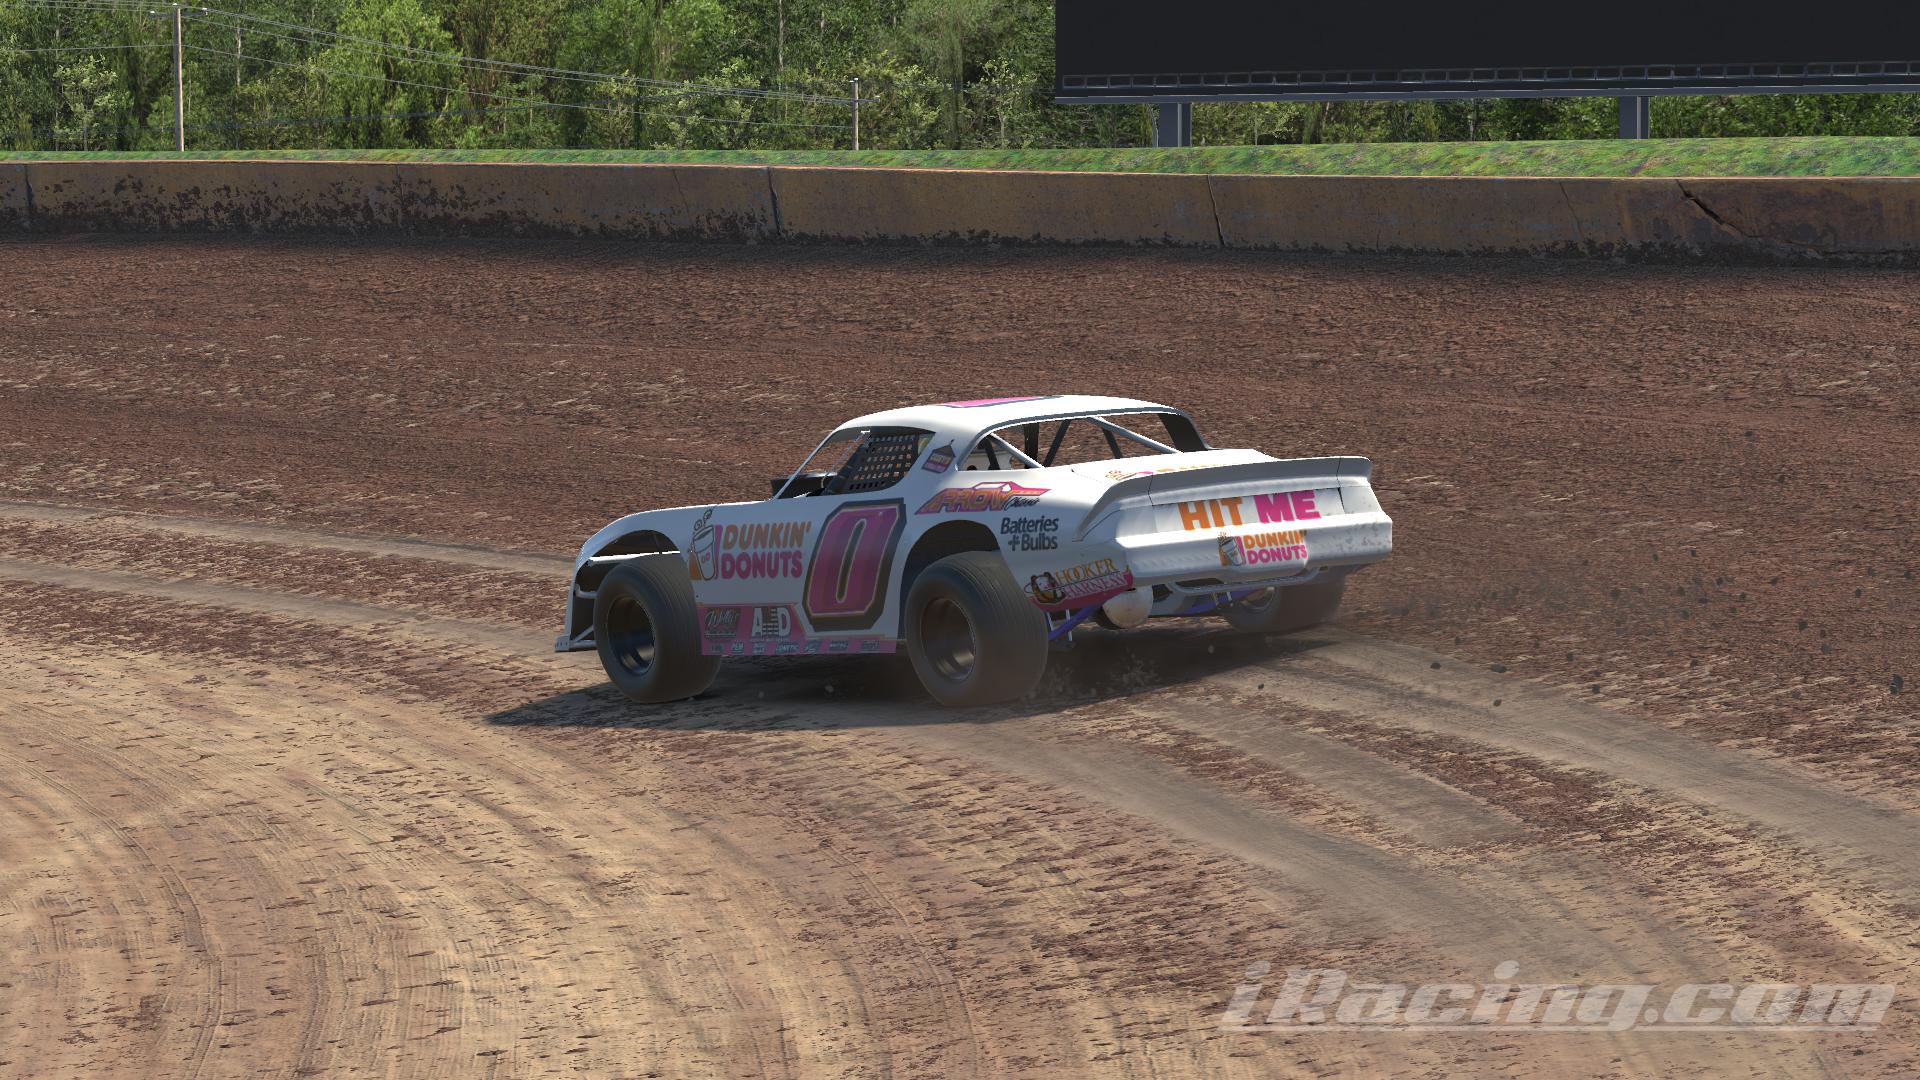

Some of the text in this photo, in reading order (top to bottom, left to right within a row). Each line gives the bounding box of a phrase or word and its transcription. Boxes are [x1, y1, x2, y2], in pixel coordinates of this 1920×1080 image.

[1178, 489, 1322, 531] HIT ME
[722, 520, 812, 550] DUNKIN'
[1001, 515, 1059, 535] Batteries
[721, 550, 803, 579] DONUTS
[802, 497, 907, 632] 0
[1246, 544, 1308, 565] DONUTS
[1055, 558, 1117, 586] HOOKER
